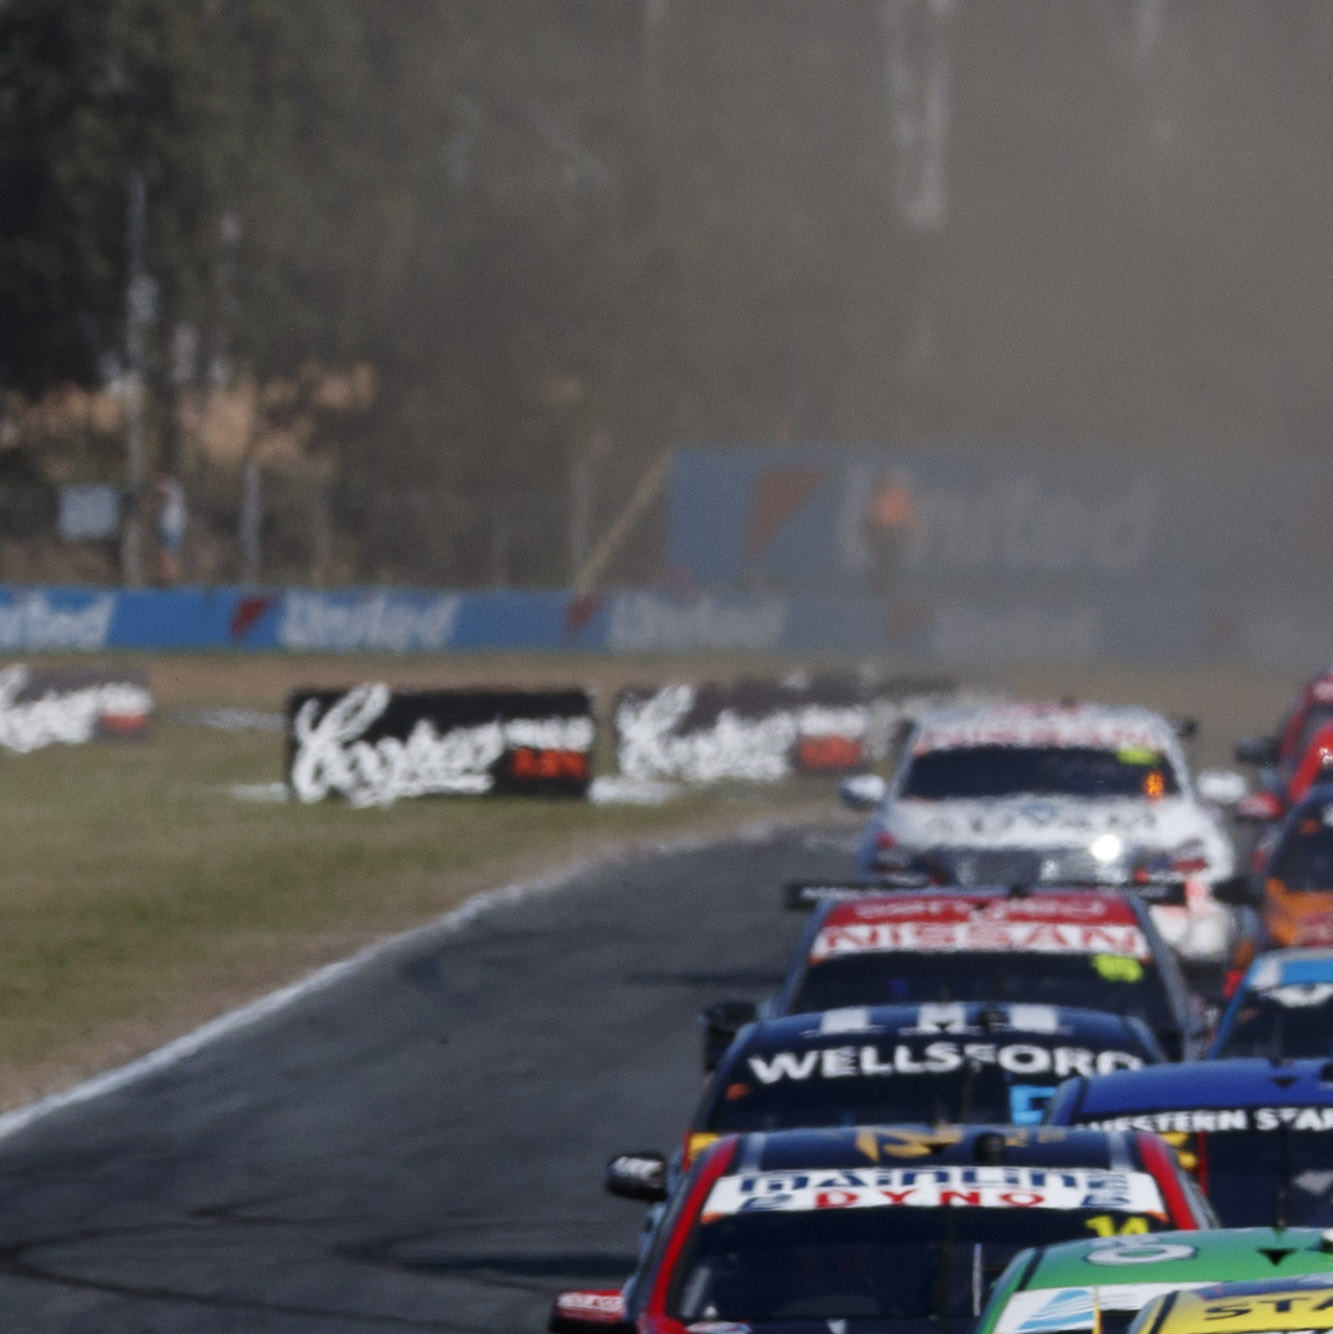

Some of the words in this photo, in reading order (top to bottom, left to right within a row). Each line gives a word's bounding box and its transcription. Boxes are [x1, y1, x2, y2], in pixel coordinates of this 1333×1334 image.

[824, 924, 1140, 950] NISSAN
[1074, 1109, 1247, 1132] ESTERN
[815, 1189, 1045, 1209] DYNO
